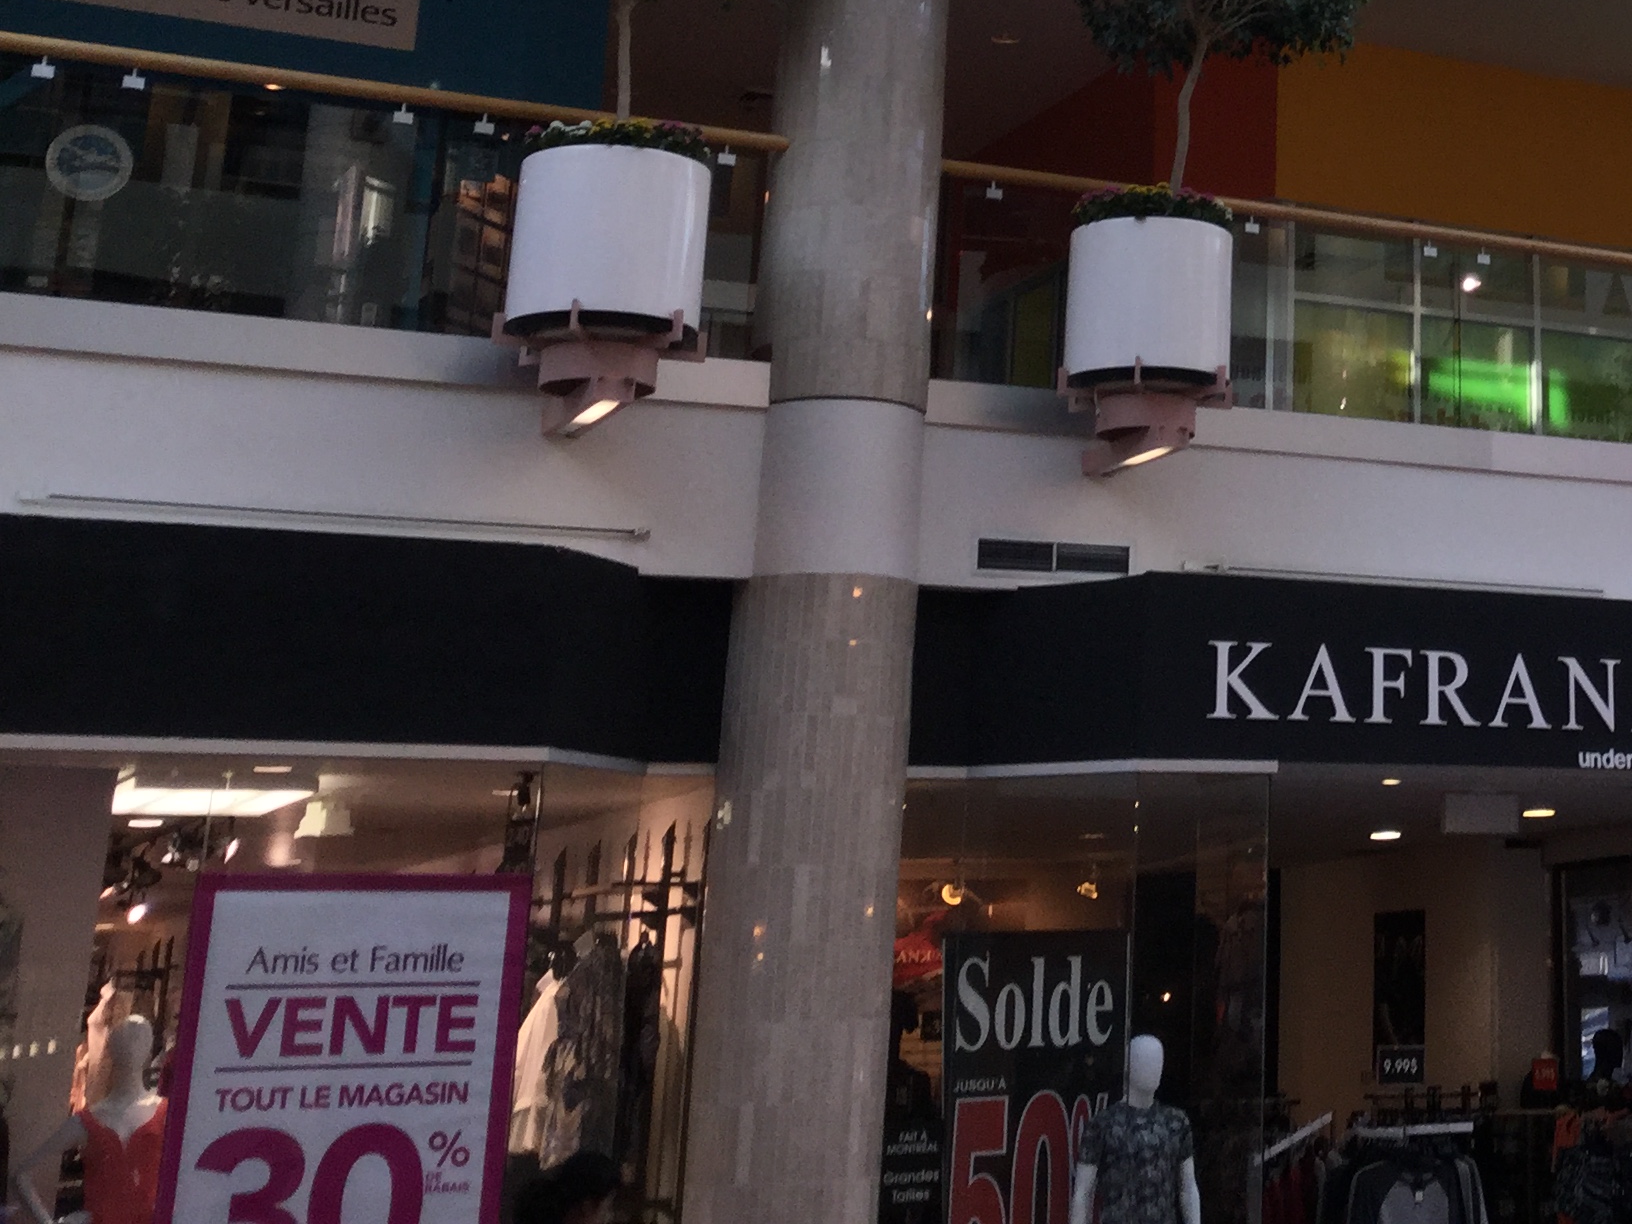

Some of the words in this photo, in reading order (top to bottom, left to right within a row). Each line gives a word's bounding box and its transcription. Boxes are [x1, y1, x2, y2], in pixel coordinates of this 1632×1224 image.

[245, 945, 320, 975] Amis
[330, 948, 360, 975] et
[369, 943, 465, 974] Famille
[954, 949, 1114, 1053] Solde
[224, 993, 480, 1059] VENTE
[1383, 1056, 1419, 1075] 9.99$
[214, 1086, 294, 1113] TOUT
[299, 1085, 332, 1111] LE
[337, 1080, 470, 1109] MAGASIN
